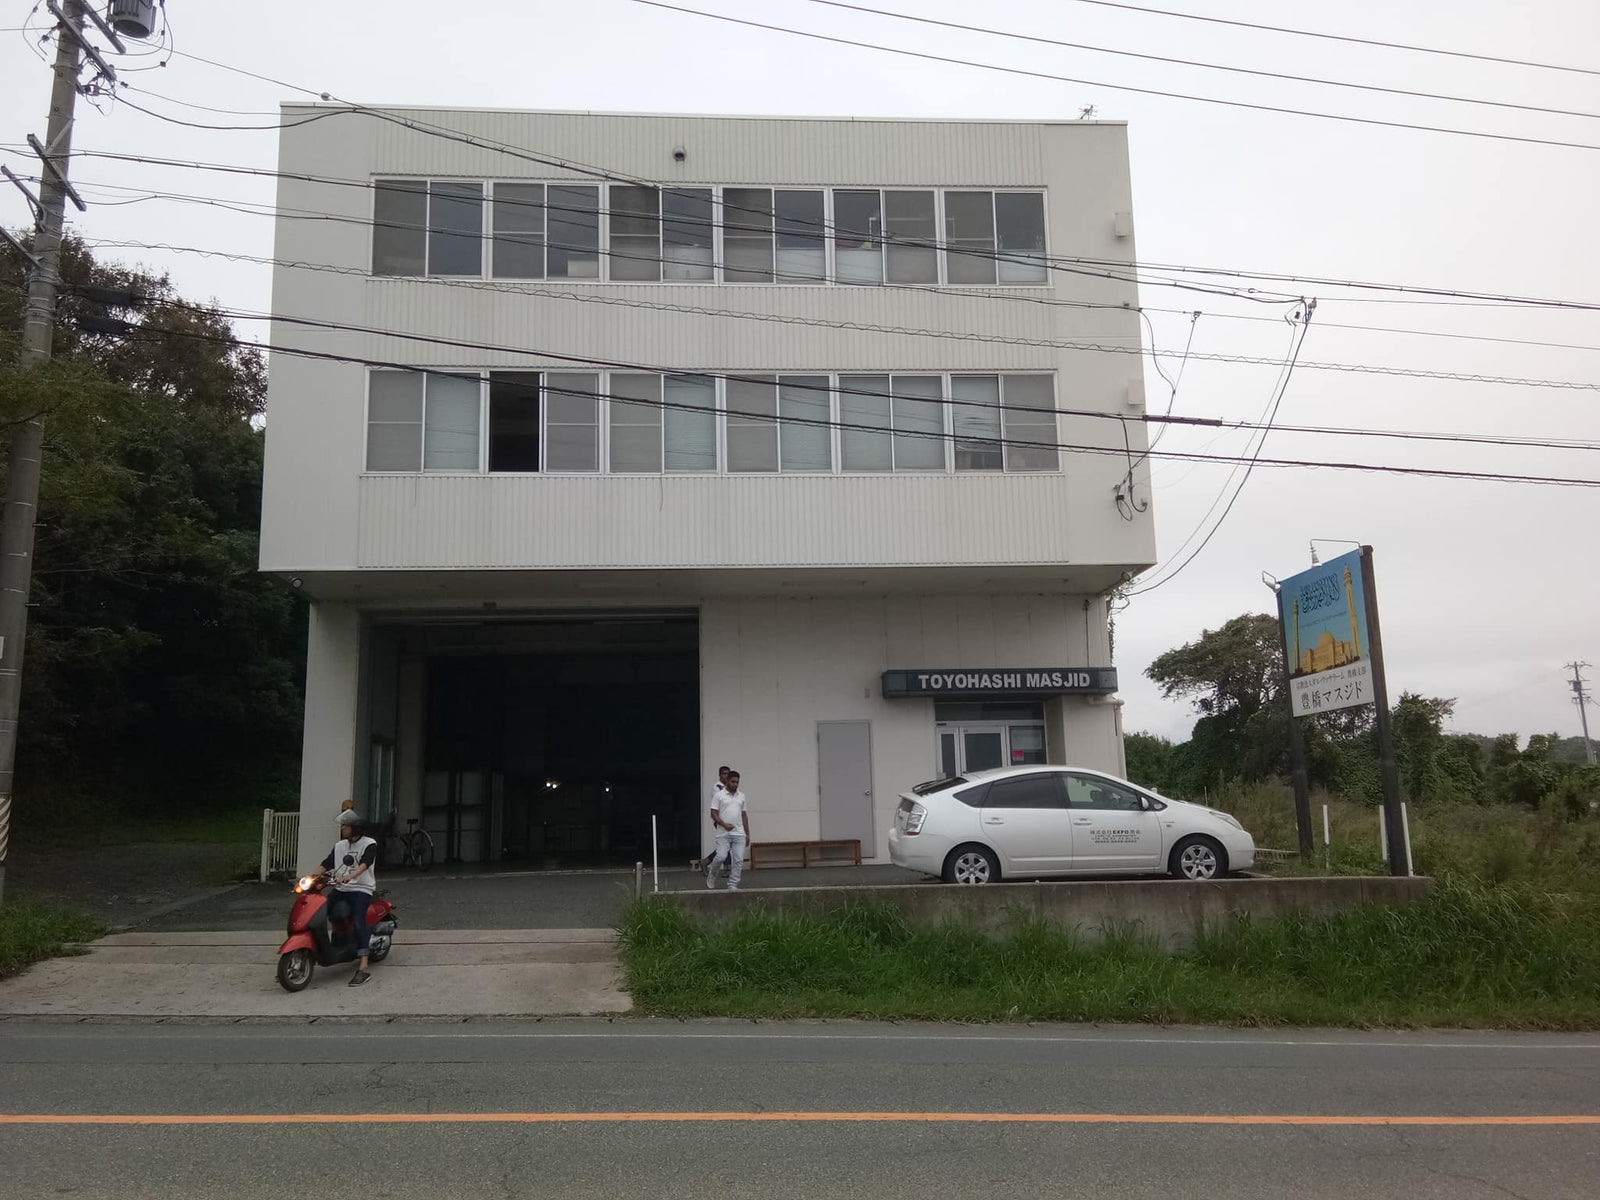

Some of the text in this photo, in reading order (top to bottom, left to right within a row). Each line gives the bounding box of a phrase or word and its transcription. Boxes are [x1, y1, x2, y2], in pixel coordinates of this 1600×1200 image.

[918, 673, 1090, 689] TOYOHASHI MASJID
[1301, 681, 1362, 710] 豊橋マスジド
